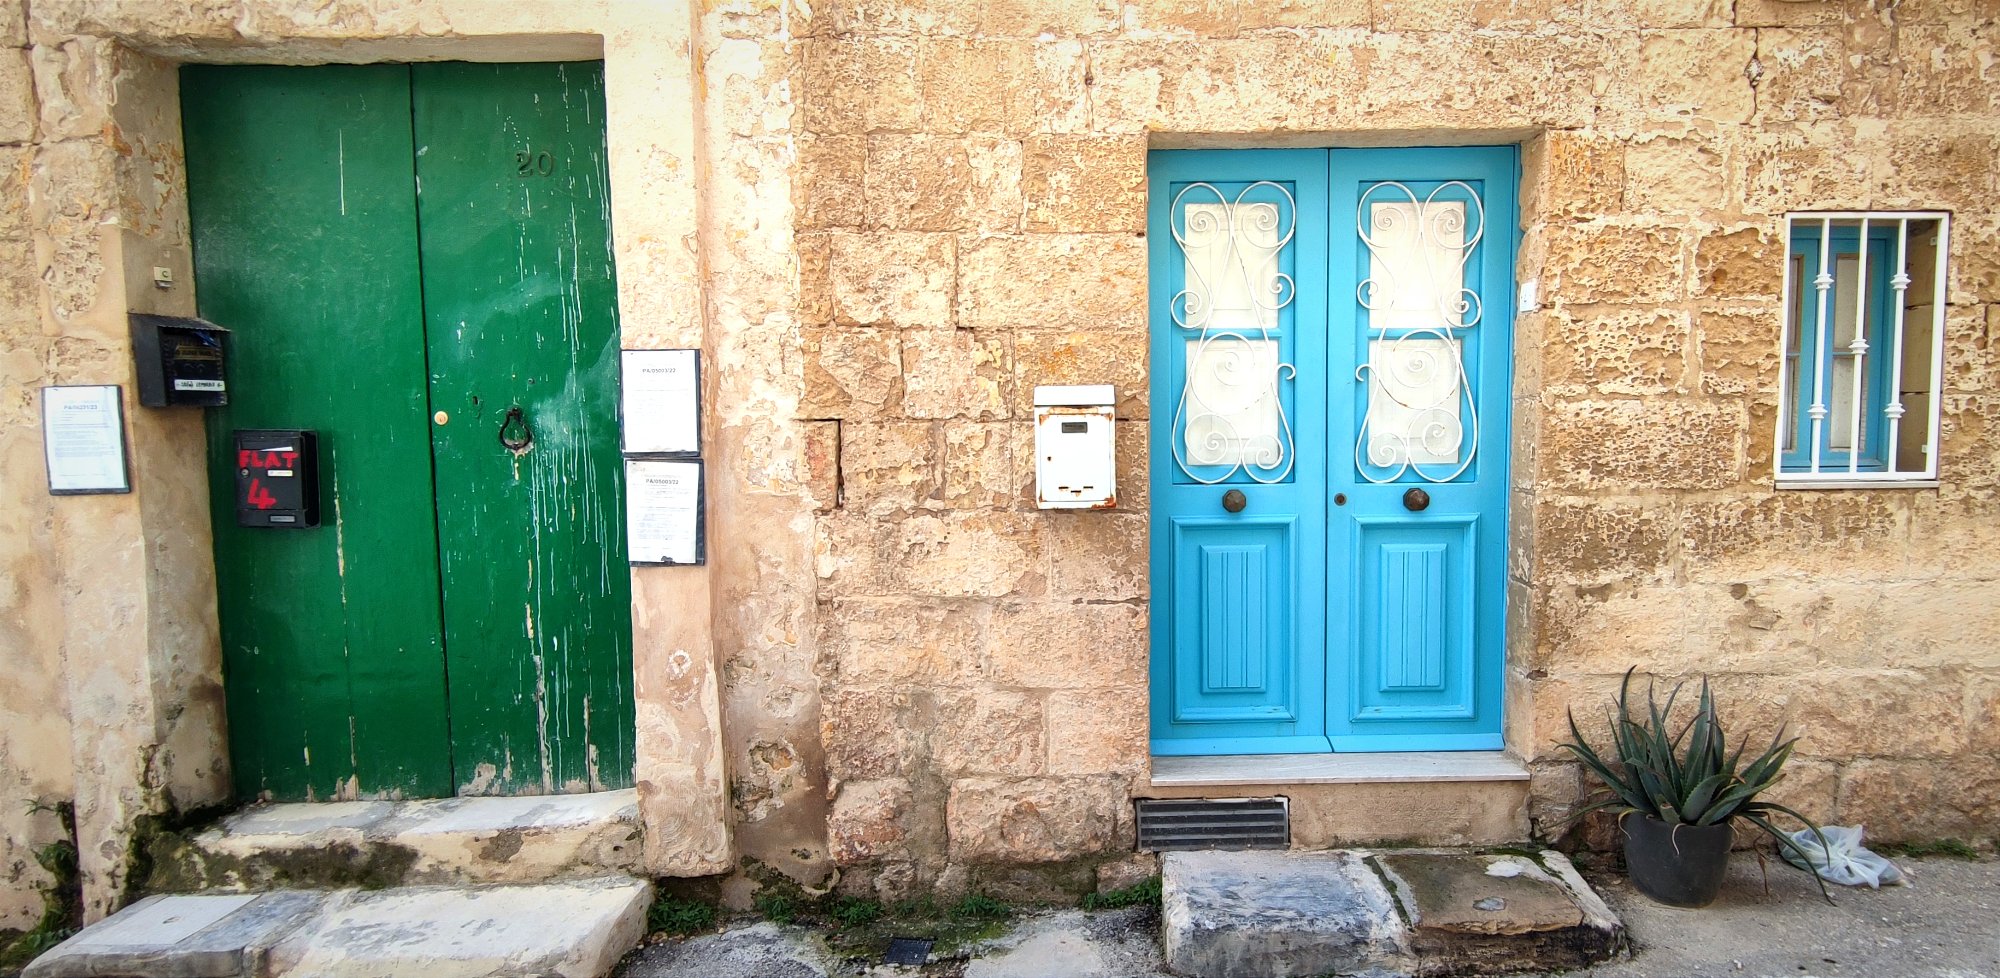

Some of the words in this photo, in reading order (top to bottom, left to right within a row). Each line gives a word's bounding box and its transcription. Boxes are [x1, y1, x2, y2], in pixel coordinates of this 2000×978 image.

[514, 149, 553, 178] 20
[238, 449, 299, 469] FLAT
[247, 478, 277, 510] 4
